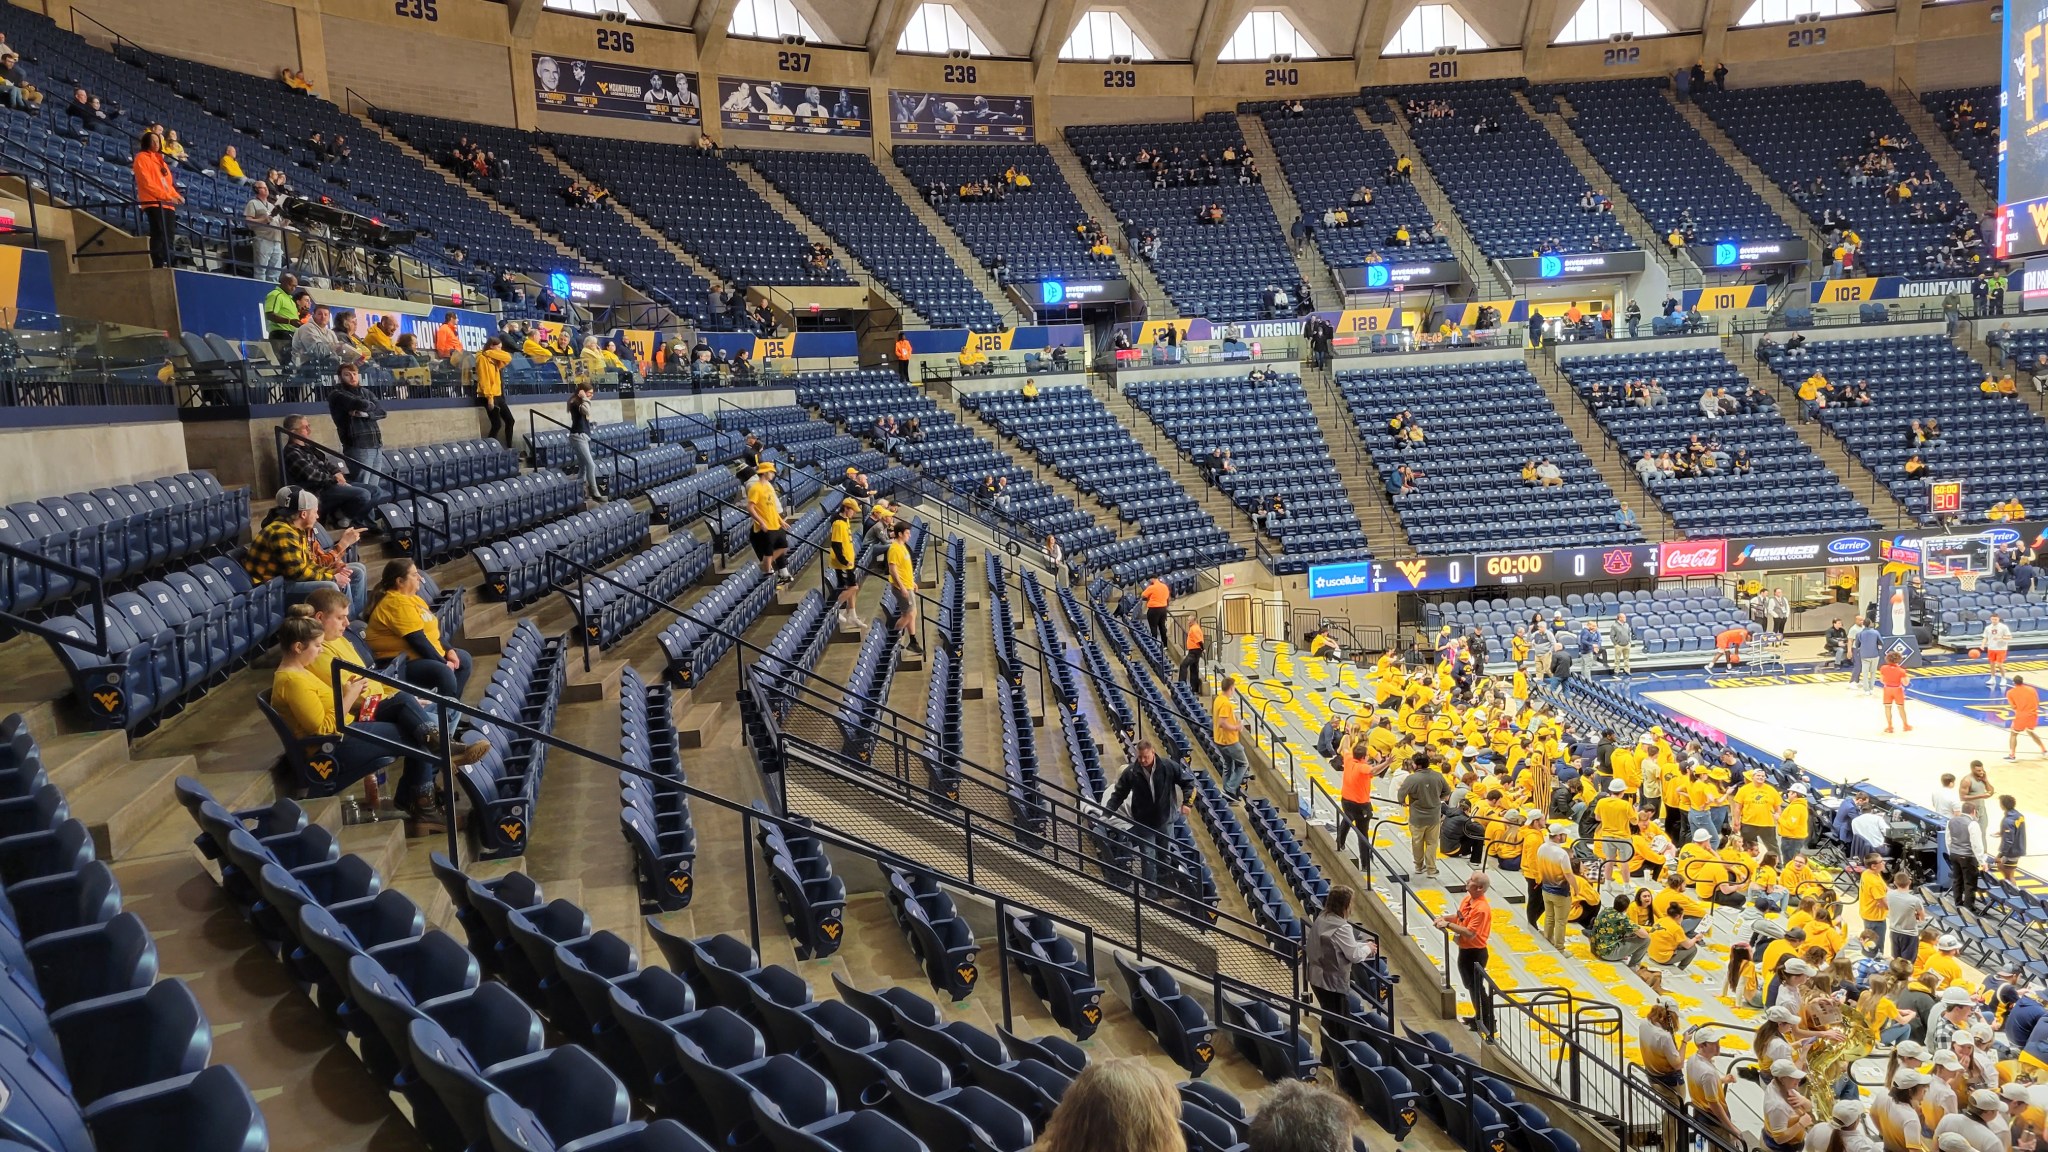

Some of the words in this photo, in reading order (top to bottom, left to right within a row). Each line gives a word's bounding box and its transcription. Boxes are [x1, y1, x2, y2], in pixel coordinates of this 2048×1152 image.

[396, 0, 438, 21] 235
[596, 28, 635, 53] 236
[1788, 27, 1826, 48] 203
[778, 52, 811, 73] 237
[1604, 47, 1640, 66] 202
[943, 64, 977, 84] 238
[1104, 70, 1136, 88] 239
[1265, 68, 1298, 86] 240
[1429, 61, 1458, 79] 201
[1714, 294, 1735, 309] 101
[1835, 286, 1861, 301] 102
[1352, 316, 1378, 331] 128
[763, 341, 785, 359] 125
[978, 335, 1001, 351] 126
[1934, 485, 1958, 494] 60:00
[1936, 494, 1955, 509] 30
[1750, 545, 1819, 558] ADVANCED
[1833, 540, 1865, 550] Carrier
[1450, 562, 1460, 583] 0
[1487, 555, 1542, 575] 60:00
[1574, 554, 1585, 576] 0
[1326, 574, 1366, 588] uscellular
